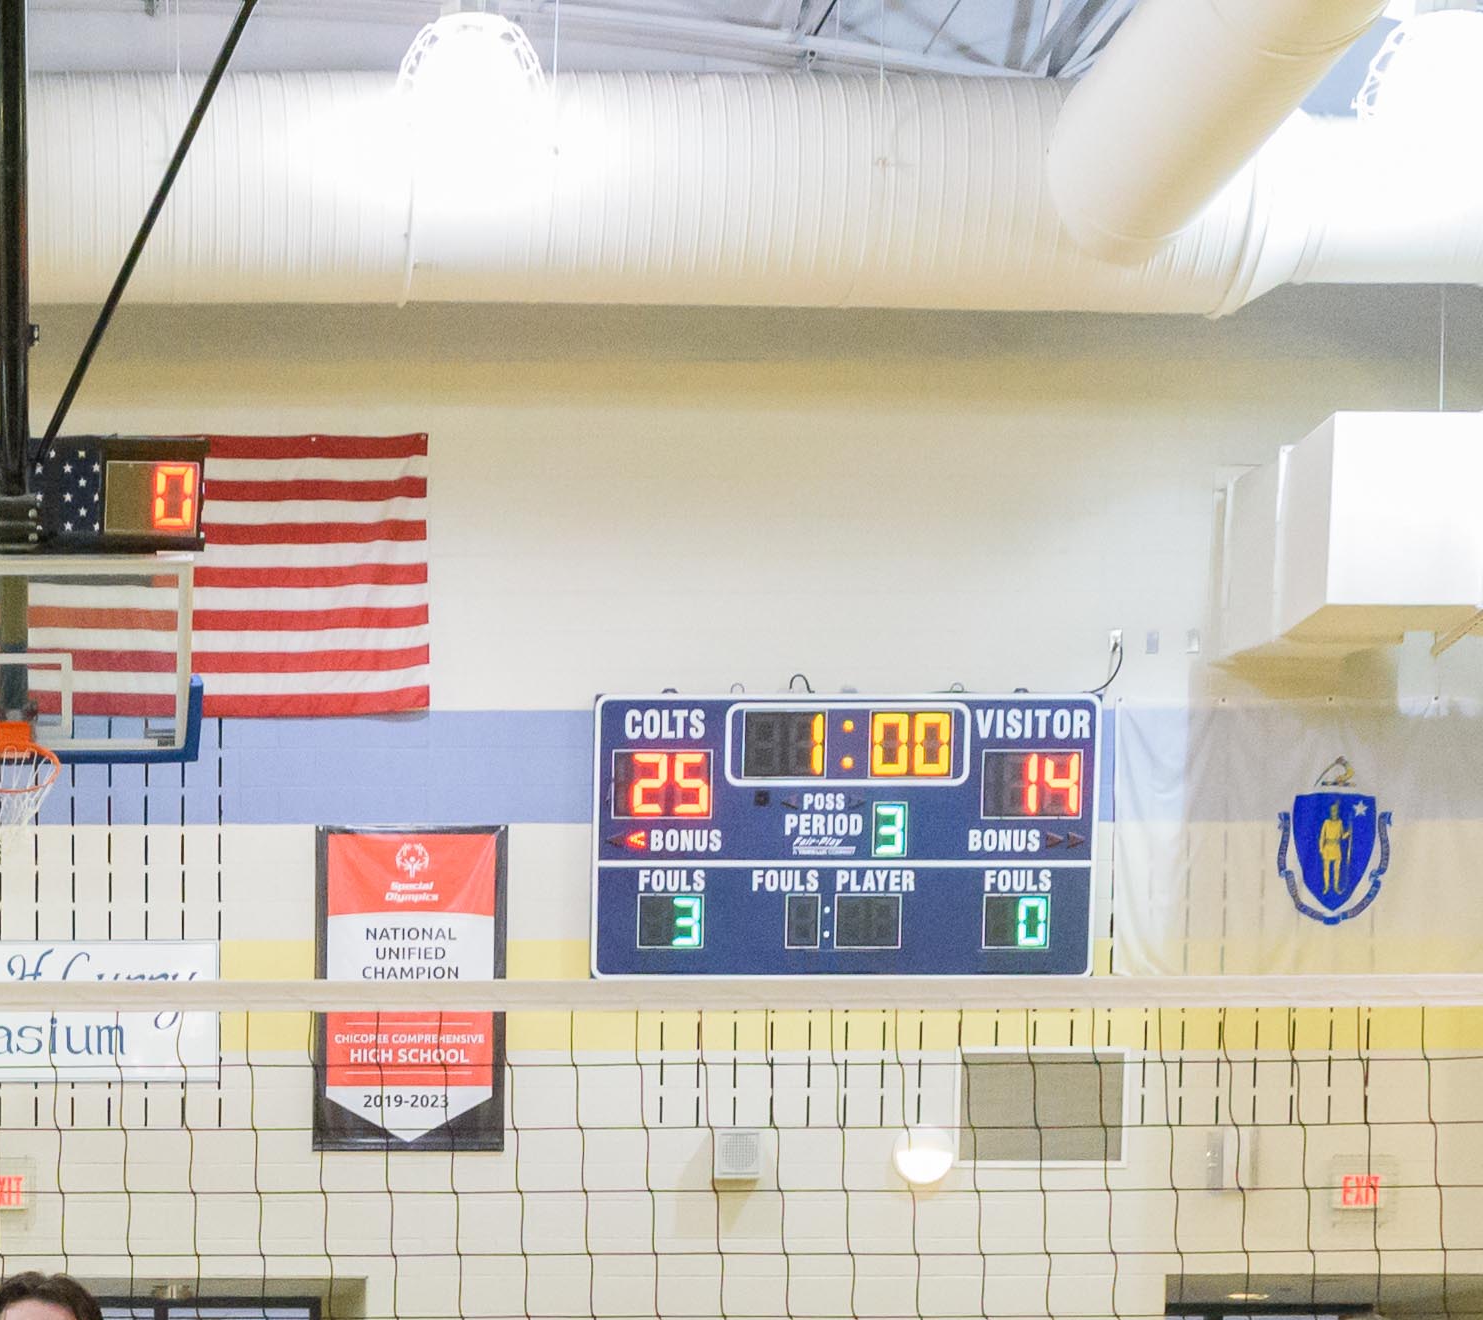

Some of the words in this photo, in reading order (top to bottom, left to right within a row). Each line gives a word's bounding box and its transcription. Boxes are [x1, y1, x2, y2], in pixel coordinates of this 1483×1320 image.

[152, 463, 197, 529] 0
[625, 709, 705, 739] COLTS
[976, 709, 1092, 739] VISITOR
[811, 712, 951, 776] 1:00
[632, 752, 711, 814] 25
[1023, 753, 1080, 814] 14
[803, 793, 845, 810] POSS
[784, 814, 863, 836] PERIOD
[876, 804, 906, 856] 3
[651, 830, 722, 853] BONUS
[968, 830, 1040, 853] BONUS
[390, 881, 434, 892] Special
[638, 870, 705, 892] FOULS
[752, 870, 819, 892] FOULS
[836, 870, 915, 893] PLAYER
[984, 870, 1051, 892] FOULS
[385, 892, 439, 904] Olympics
[672, 897, 701, 946] 3
[1017, 897, 1046, 946] 0
[365, 927, 457, 941] NATIONAL
[375, 946, 446, 961] UNIFIED
[362, 966, 459, 980] CHAMPION
[334, 1033, 389, 1044] CHICOPEE
[391, 1033, 485, 1044] COMPREHENSIVE
[350, 1049, 393, 1063] HIGH
[397, 1049, 470, 1064] SCHOOL
[363, 1095, 449, 1109] 2019-2023
[1341, 1174, 1381, 1206] EXIT
